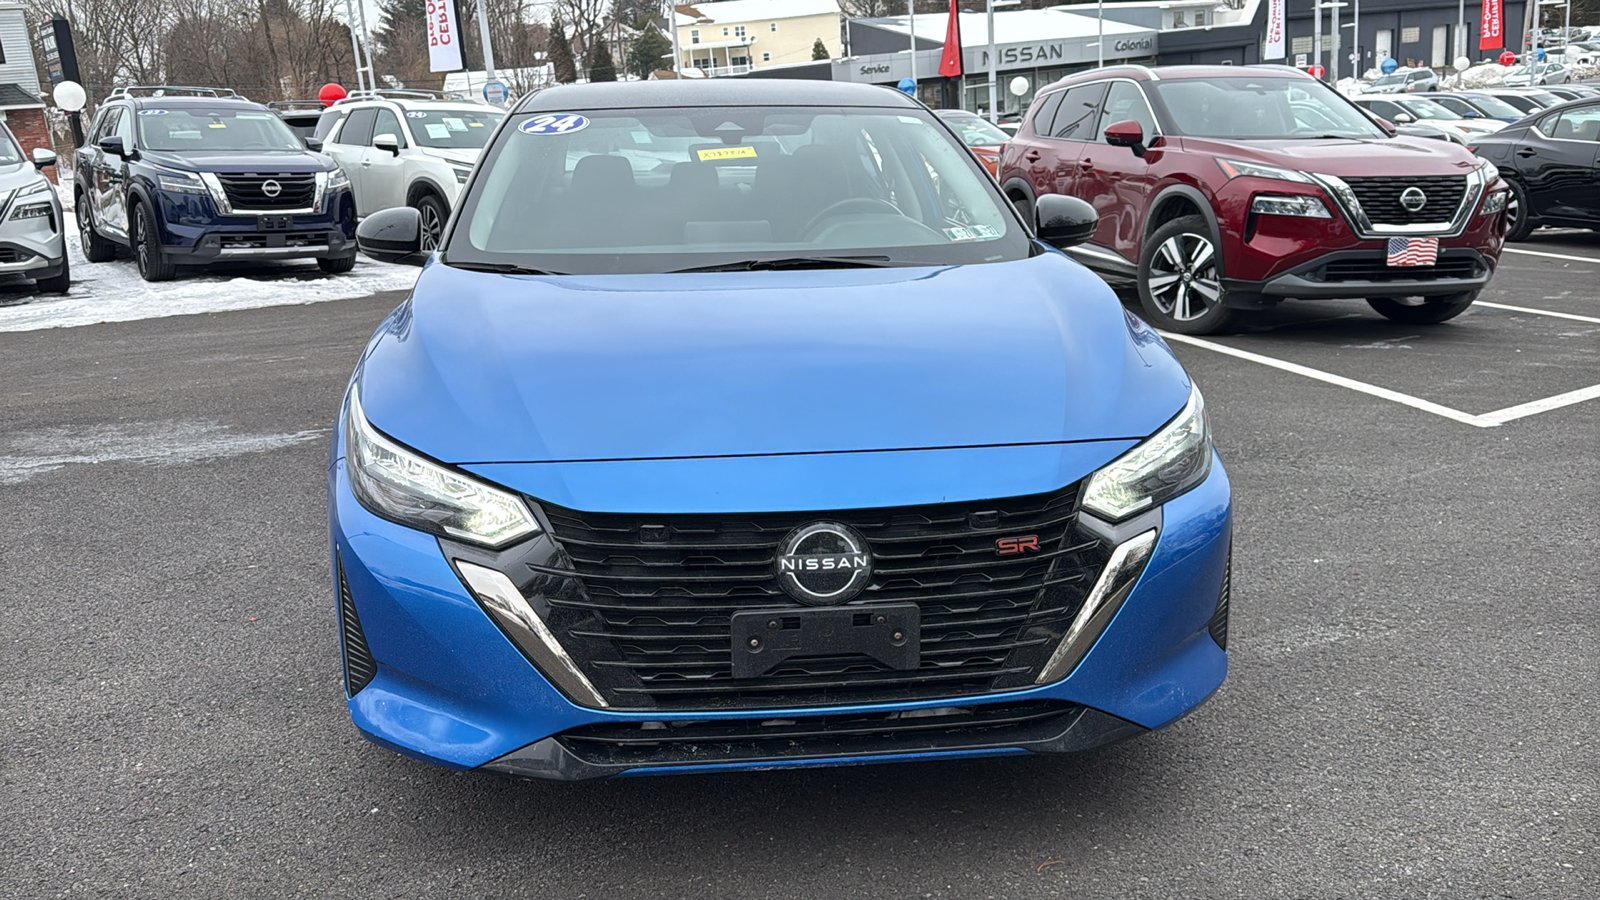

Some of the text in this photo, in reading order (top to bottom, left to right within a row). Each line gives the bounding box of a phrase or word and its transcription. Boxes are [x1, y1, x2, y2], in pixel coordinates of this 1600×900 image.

[1115, 38, 1153, 51] Colonial
[860, 64, 890, 75] Service
[524, 115, 583, 132] 24
[998, 536, 1039, 554] SR
[781, 555, 867, 571] NISSAN
